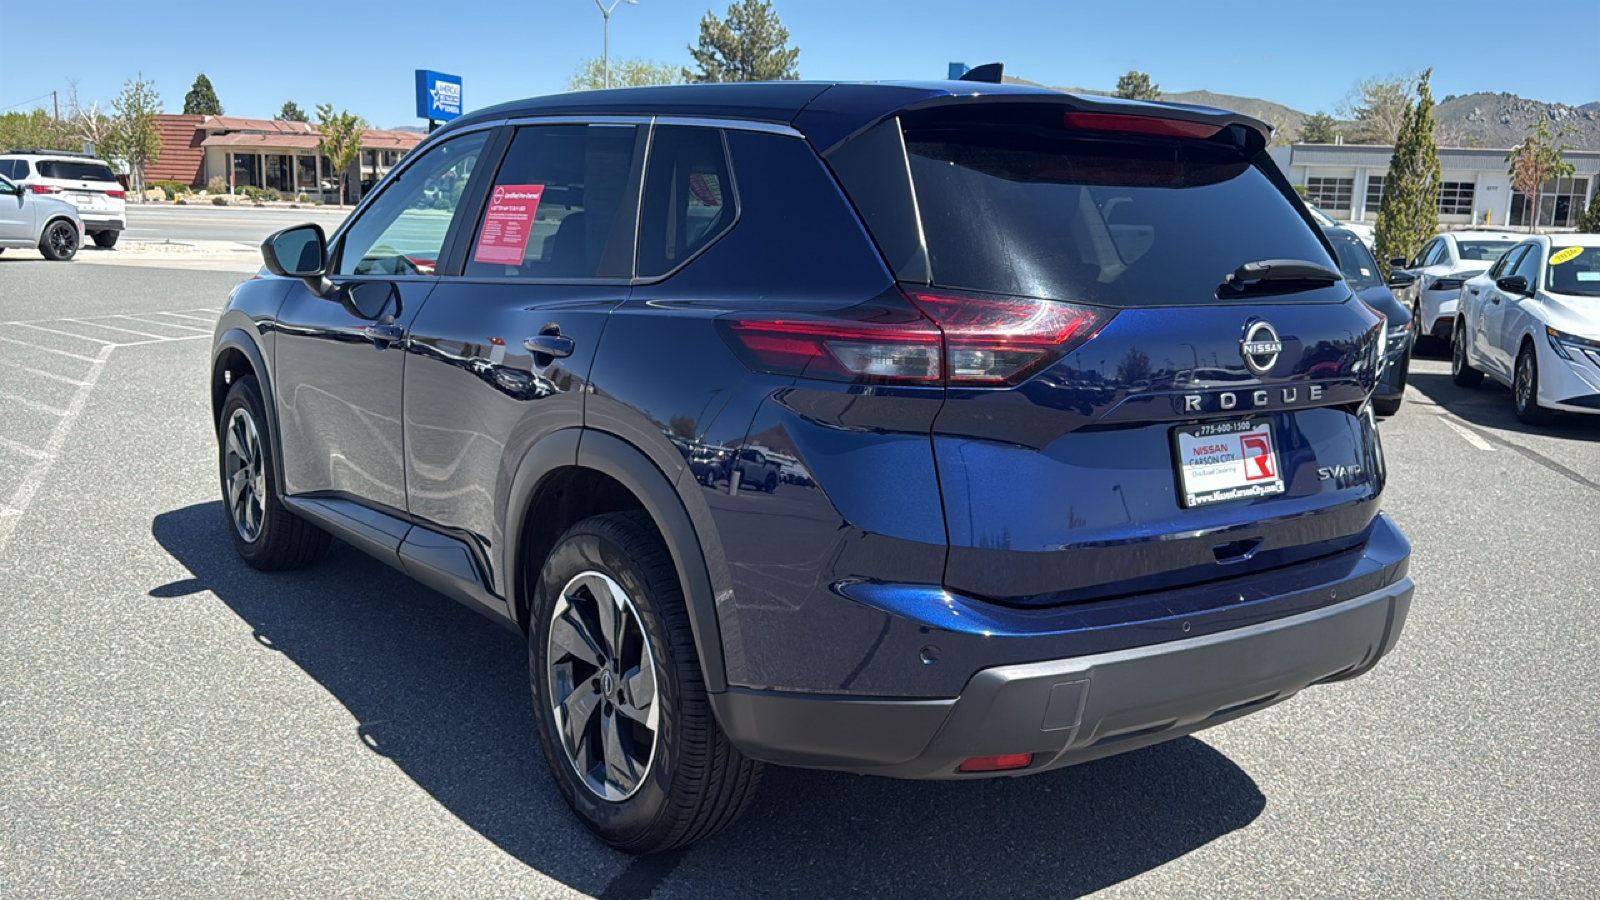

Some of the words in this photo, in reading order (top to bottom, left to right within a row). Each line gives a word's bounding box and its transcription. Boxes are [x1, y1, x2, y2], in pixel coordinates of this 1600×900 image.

[1243, 344, 1282, 353] NISSAN
[1184, 385, 1322, 411] ROGUE
[1201, 421, 1250, 434] 775-600-1500
[1192, 444, 1228, 456] NISSAN
[1189, 457, 1220, 467] CARSON
[1220, 454, 1235, 464] CITY
[1318, 464, 1340, 480] SV
